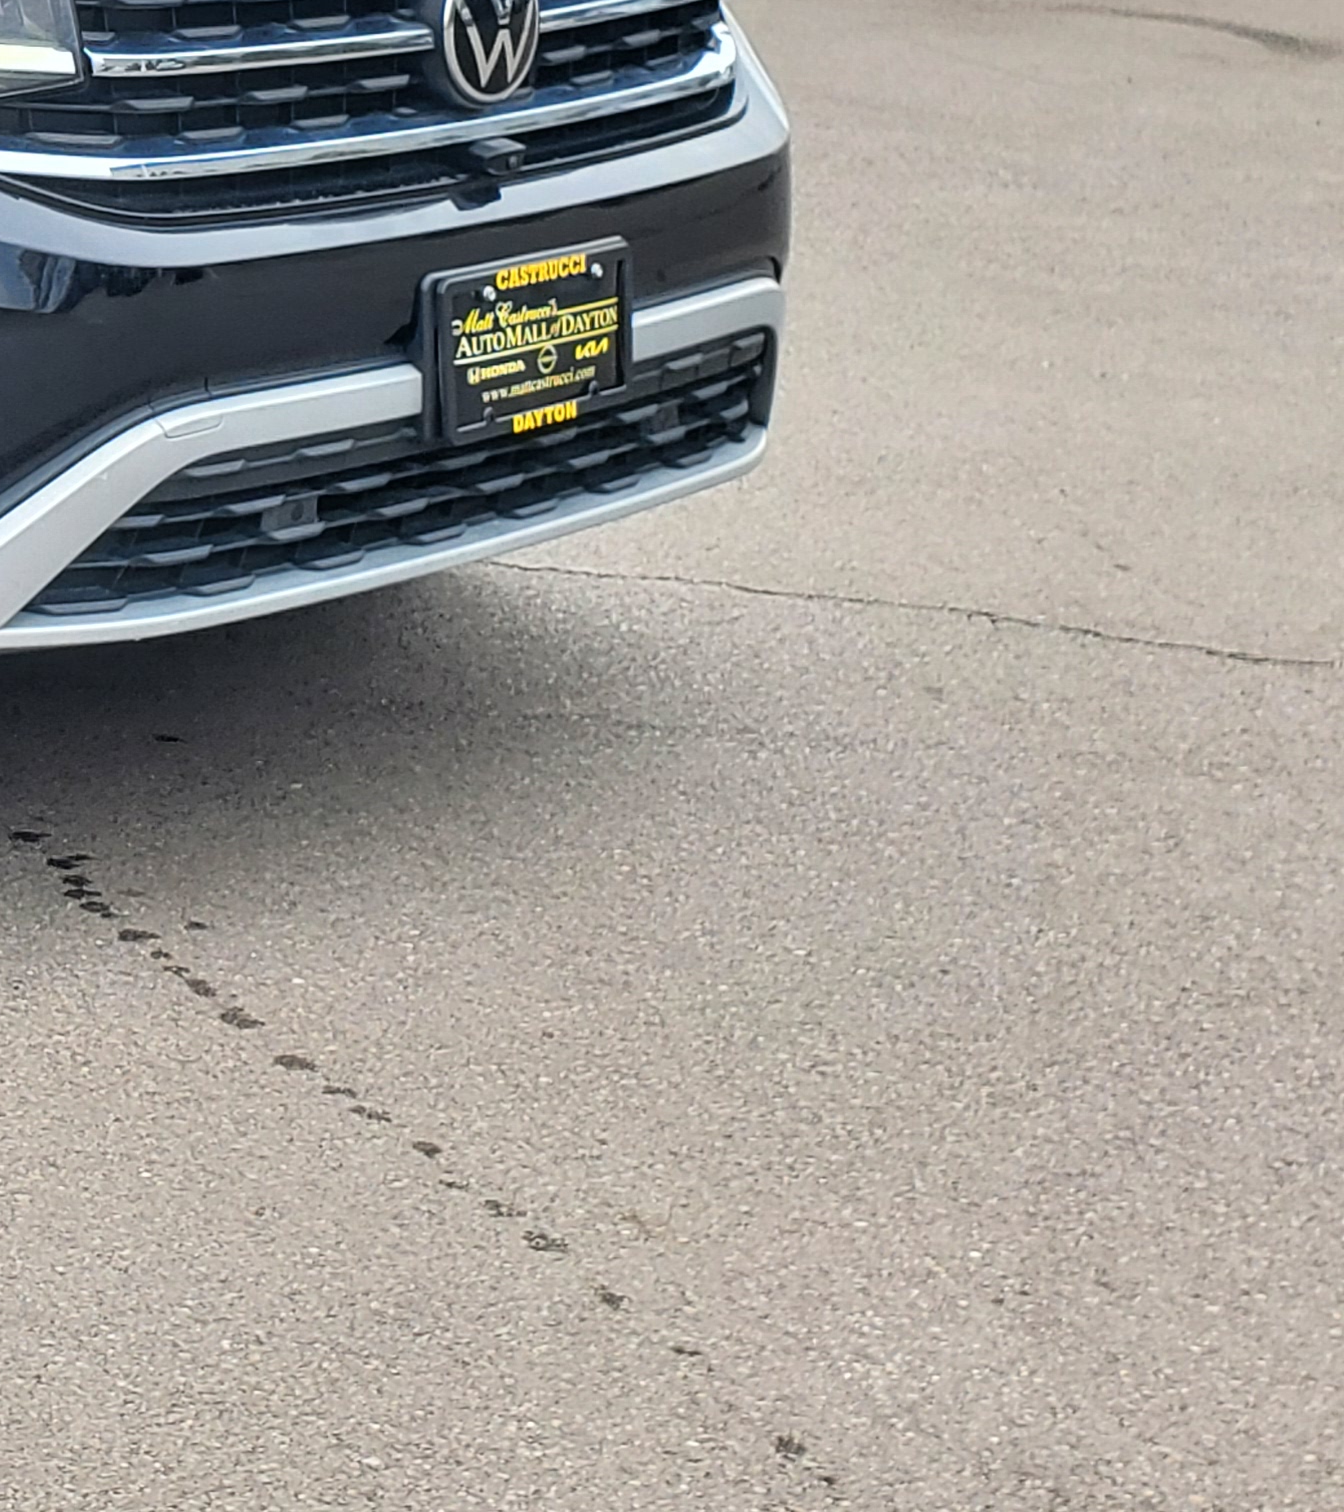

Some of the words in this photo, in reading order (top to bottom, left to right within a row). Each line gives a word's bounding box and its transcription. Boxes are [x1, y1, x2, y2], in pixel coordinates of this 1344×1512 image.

[495, 253, 588, 291] CASTRUCCI
[561, 305, 618, 336] DAYTON
[480, 359, 527, 380] HONDA
[575, 336, 610, 361] KIA
[512, 399, 578, 434] DAYTON
